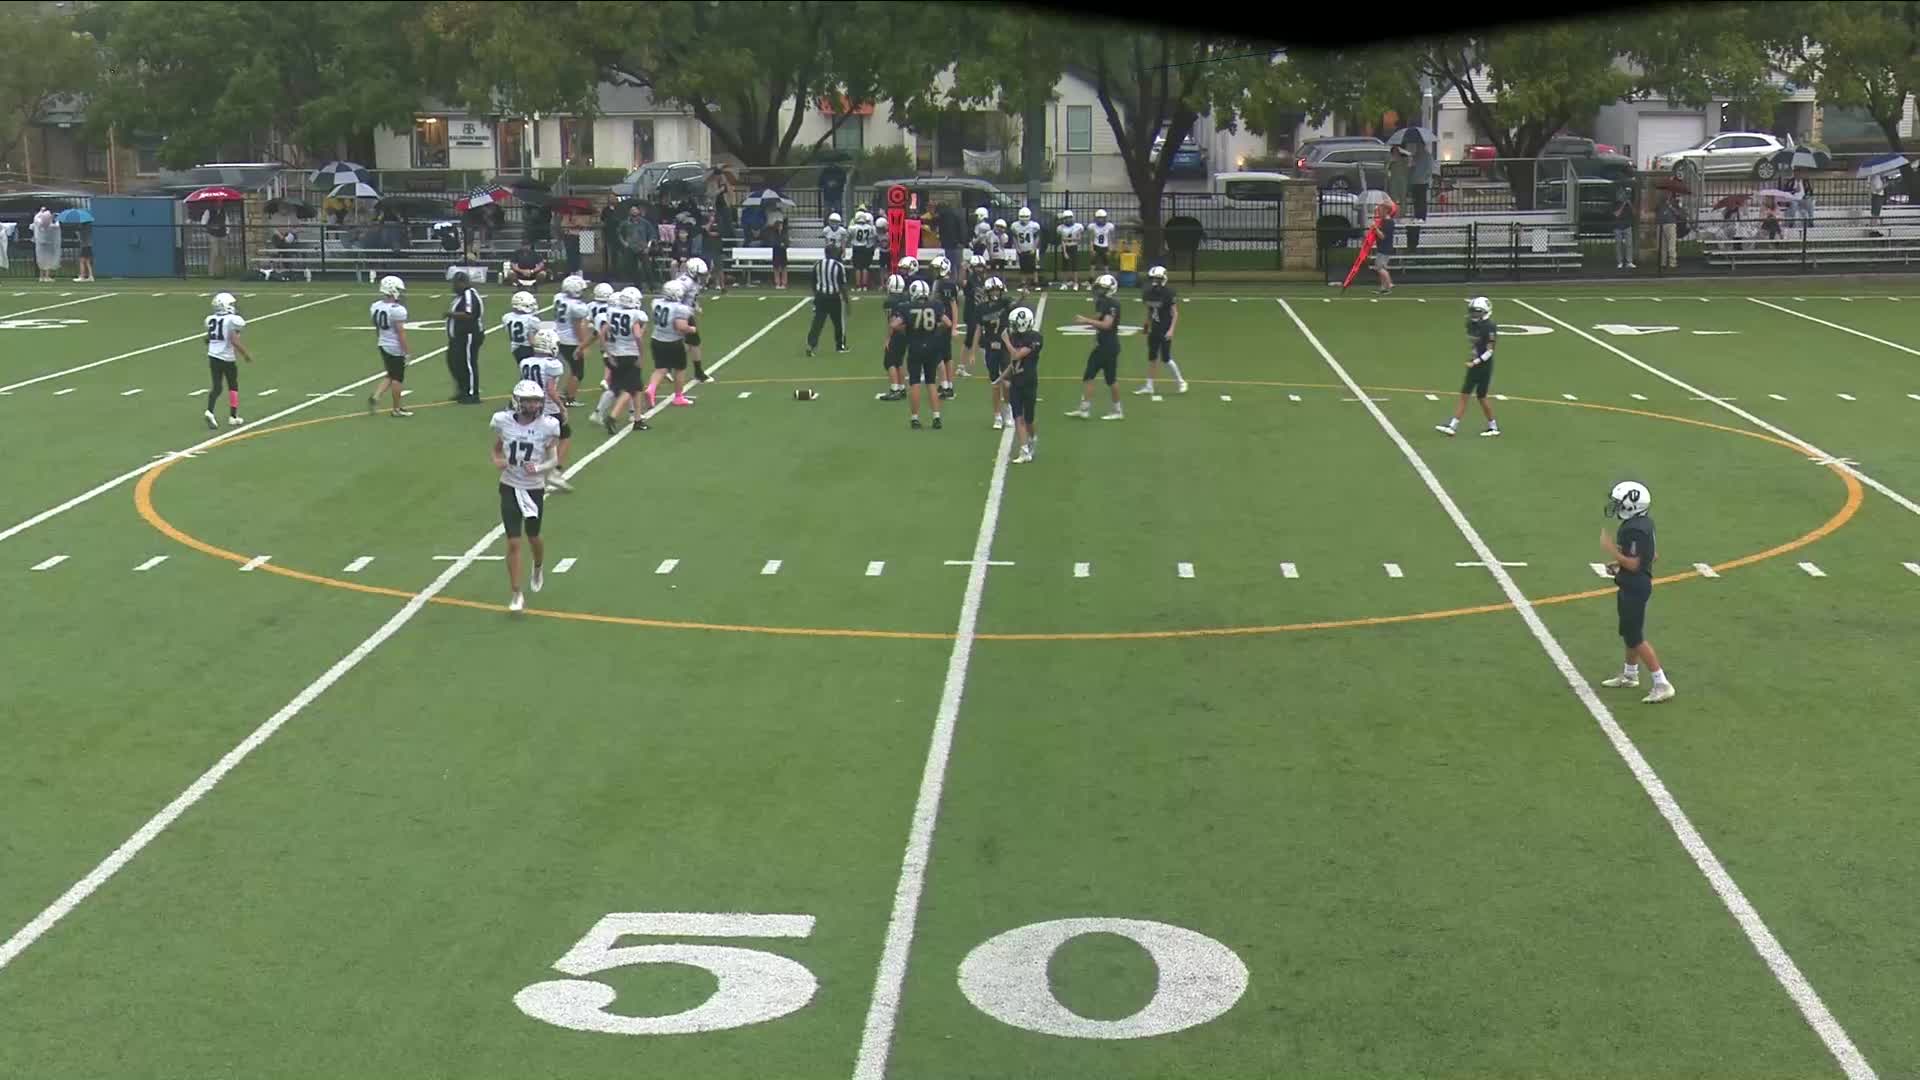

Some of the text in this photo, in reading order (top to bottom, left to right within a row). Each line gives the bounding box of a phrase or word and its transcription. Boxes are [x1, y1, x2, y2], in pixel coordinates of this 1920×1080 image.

[1018, 233, 1031, 244] 54
[208, 318, 225, 341] 21
[372, 309, 389, 330] 10
[610, 312, 631, 337] 59
[909, 308, 936, 331] 78
[506, 320, 525, 343] 12
[508, 440, 534, 467] 17
[513, 910, 1250, 1040] 50
